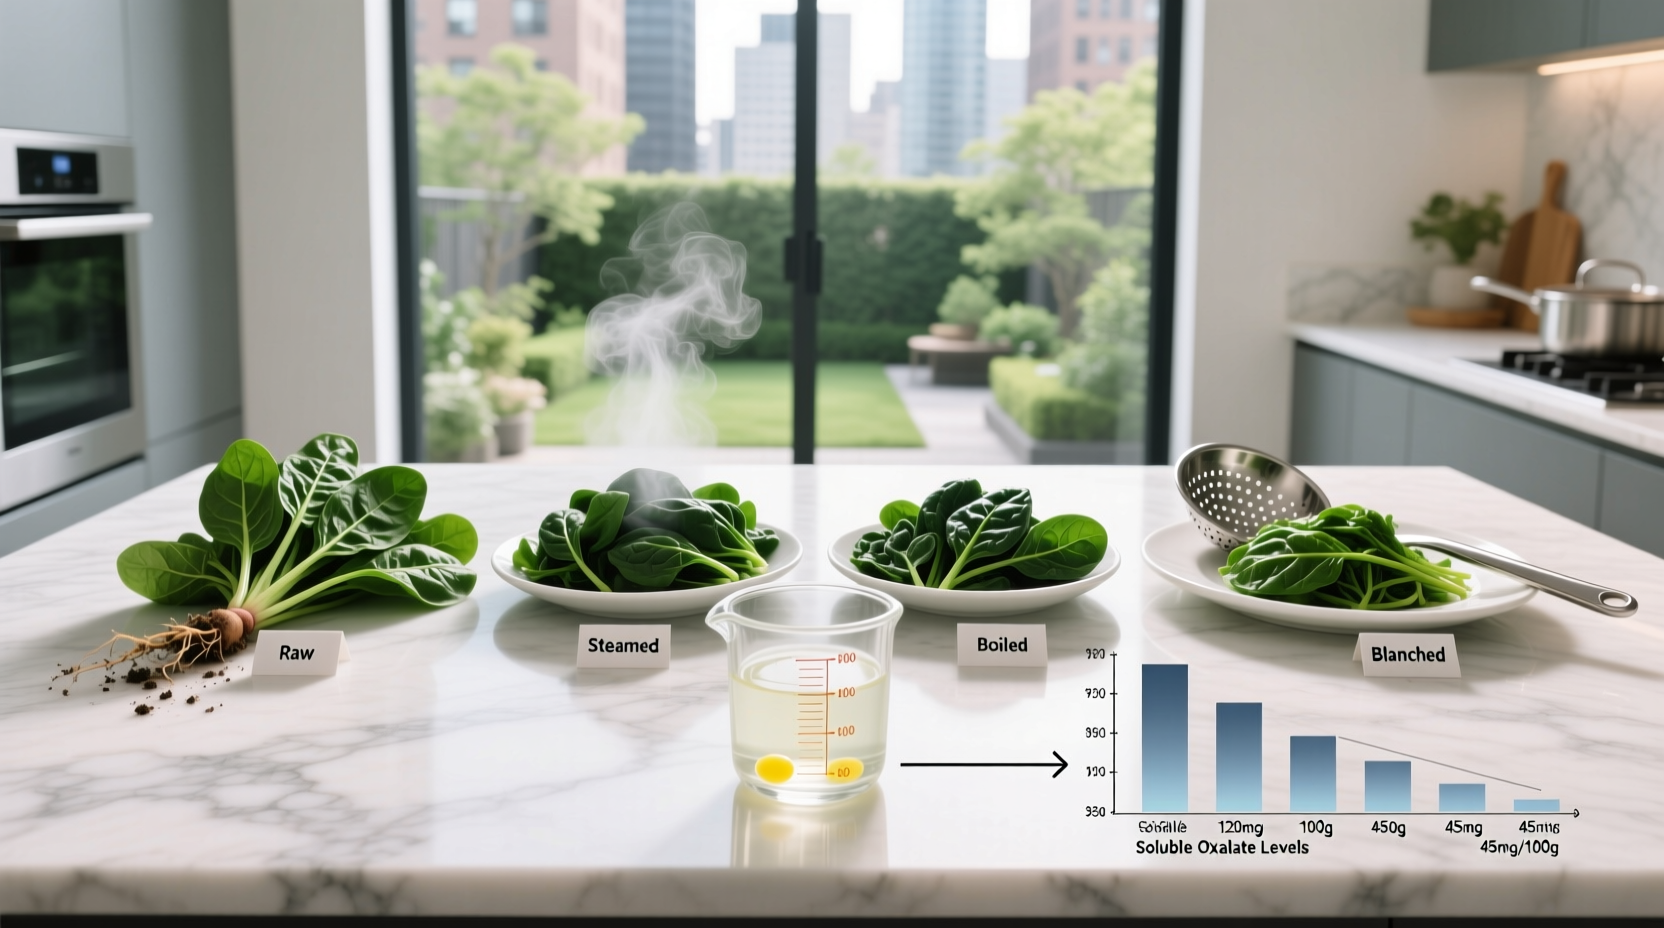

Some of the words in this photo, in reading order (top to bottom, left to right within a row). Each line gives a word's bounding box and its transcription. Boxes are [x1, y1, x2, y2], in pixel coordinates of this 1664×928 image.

[279, 644, 315, 661] Raw
[588, 637, 660, 654] Steamed
[977, 636, 1028, 653] Boiled
[1371, 645, 1446, 663] Blanched
